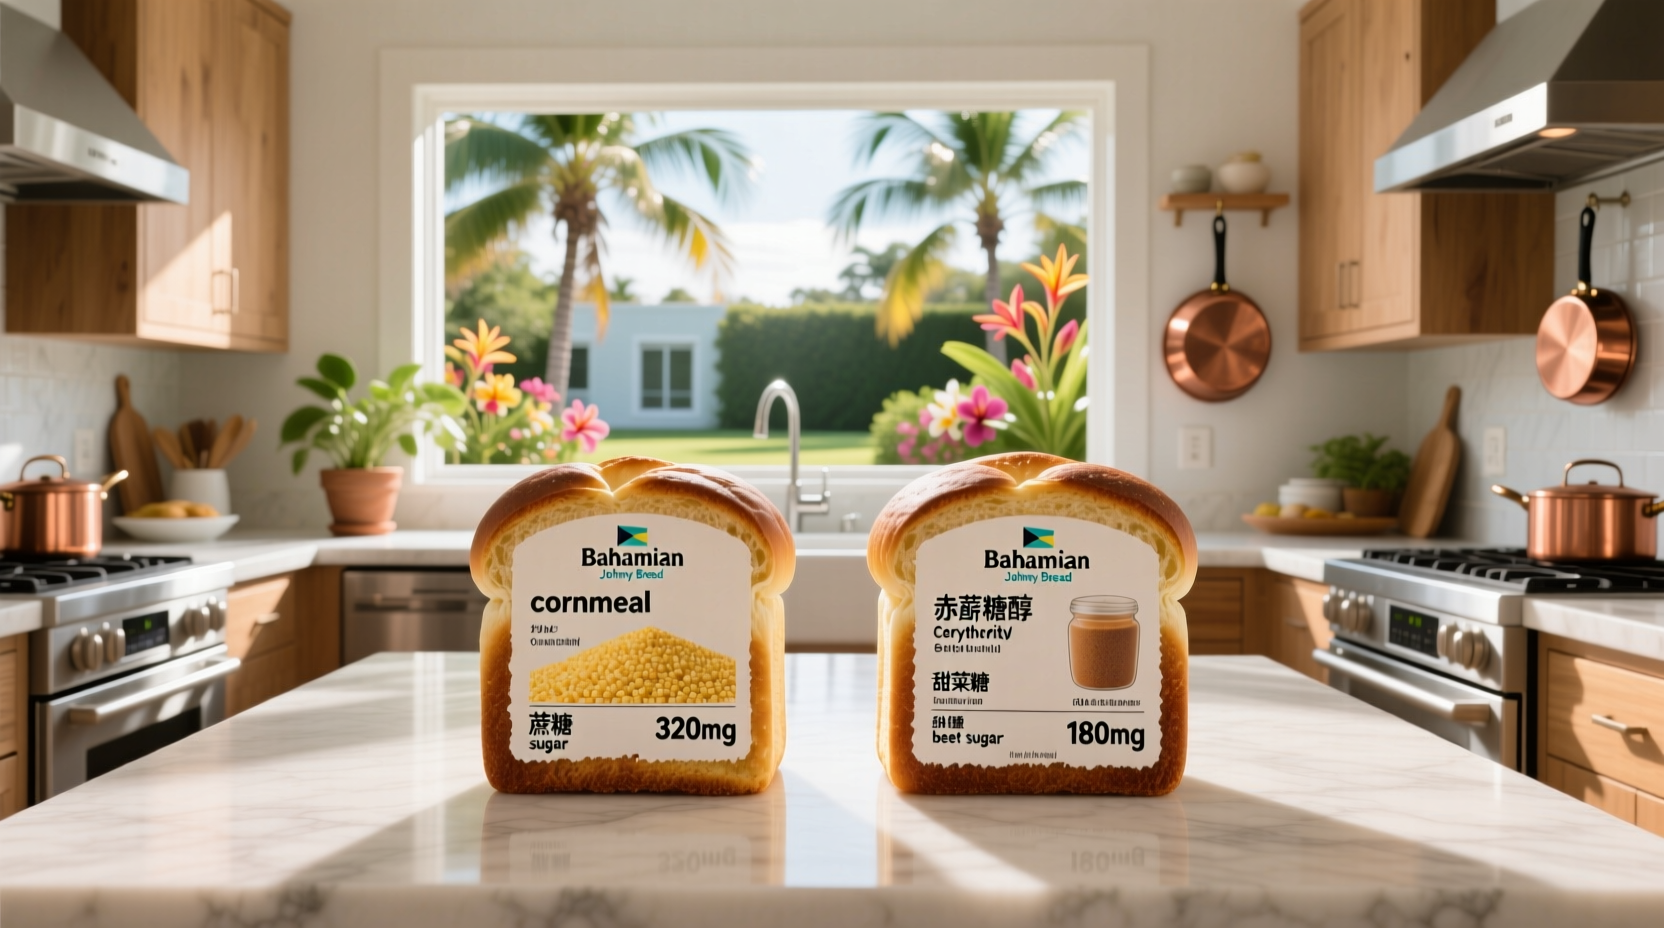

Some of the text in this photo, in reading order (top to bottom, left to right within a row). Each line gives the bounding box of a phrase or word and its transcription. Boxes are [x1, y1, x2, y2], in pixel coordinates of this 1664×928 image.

[581, 547, 684, 567] Bahamian
[983, 549, 1090, 570] Bahamian
[1041, 571, 1073, 583] Bread
[530, 590, 651, 614] cornmeal
[931, 670, 990, 693] 甜菜糖
[528, 711, 573, 737] 蔗糖
[655, 716, 737, 747] 320mg
[528, 739, 569, 754] sugar
[965, 733, 1005, 748] sugar
[1066, 720, 1145, 752] 180mg
